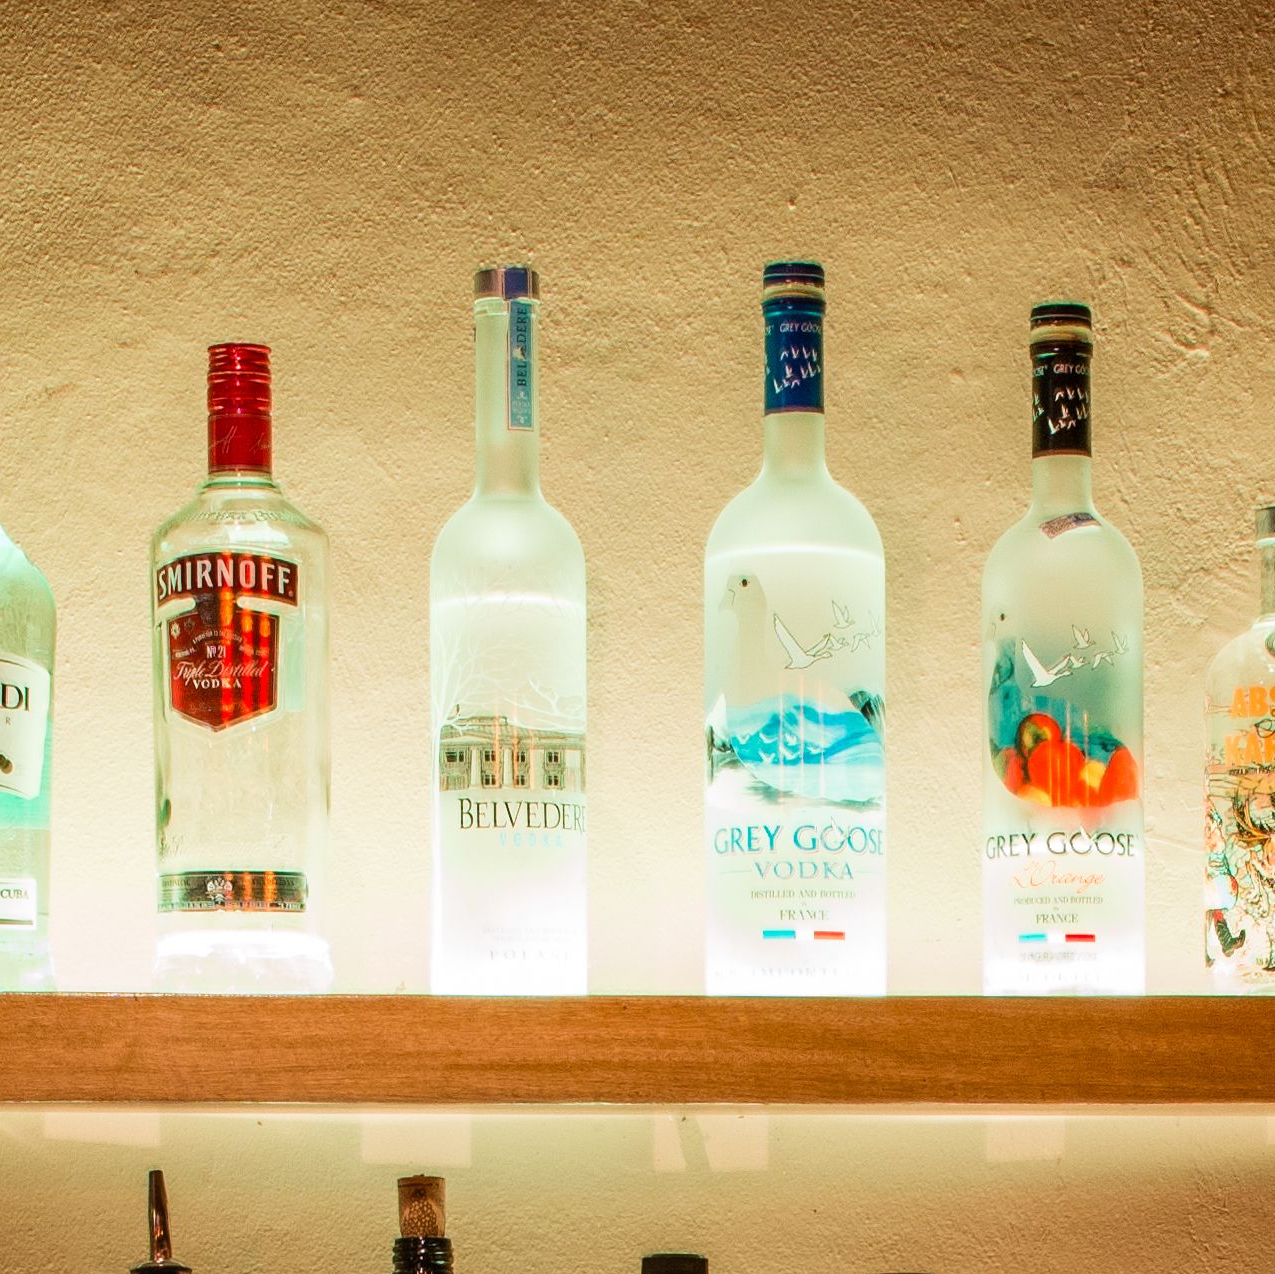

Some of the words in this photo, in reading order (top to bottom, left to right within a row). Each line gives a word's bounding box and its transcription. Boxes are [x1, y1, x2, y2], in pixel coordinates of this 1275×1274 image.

[158, 558, 291, 600] SMIRNOFF
[192, 677, 243, 690] VODKA
[714, 824, 782, 855] GREY
[793, 823, 884, 856] GOOSE
[985, 832, 1039, 860] GREY
[1045, 830, 1136, 857] GOOSE
[753, 860, 854, 880] VODKA
[0, 888, 30, 900] CUBA
[779, 909, 829, 922] FRANCE
[1035, 913, 1079, 924] FRANCE
